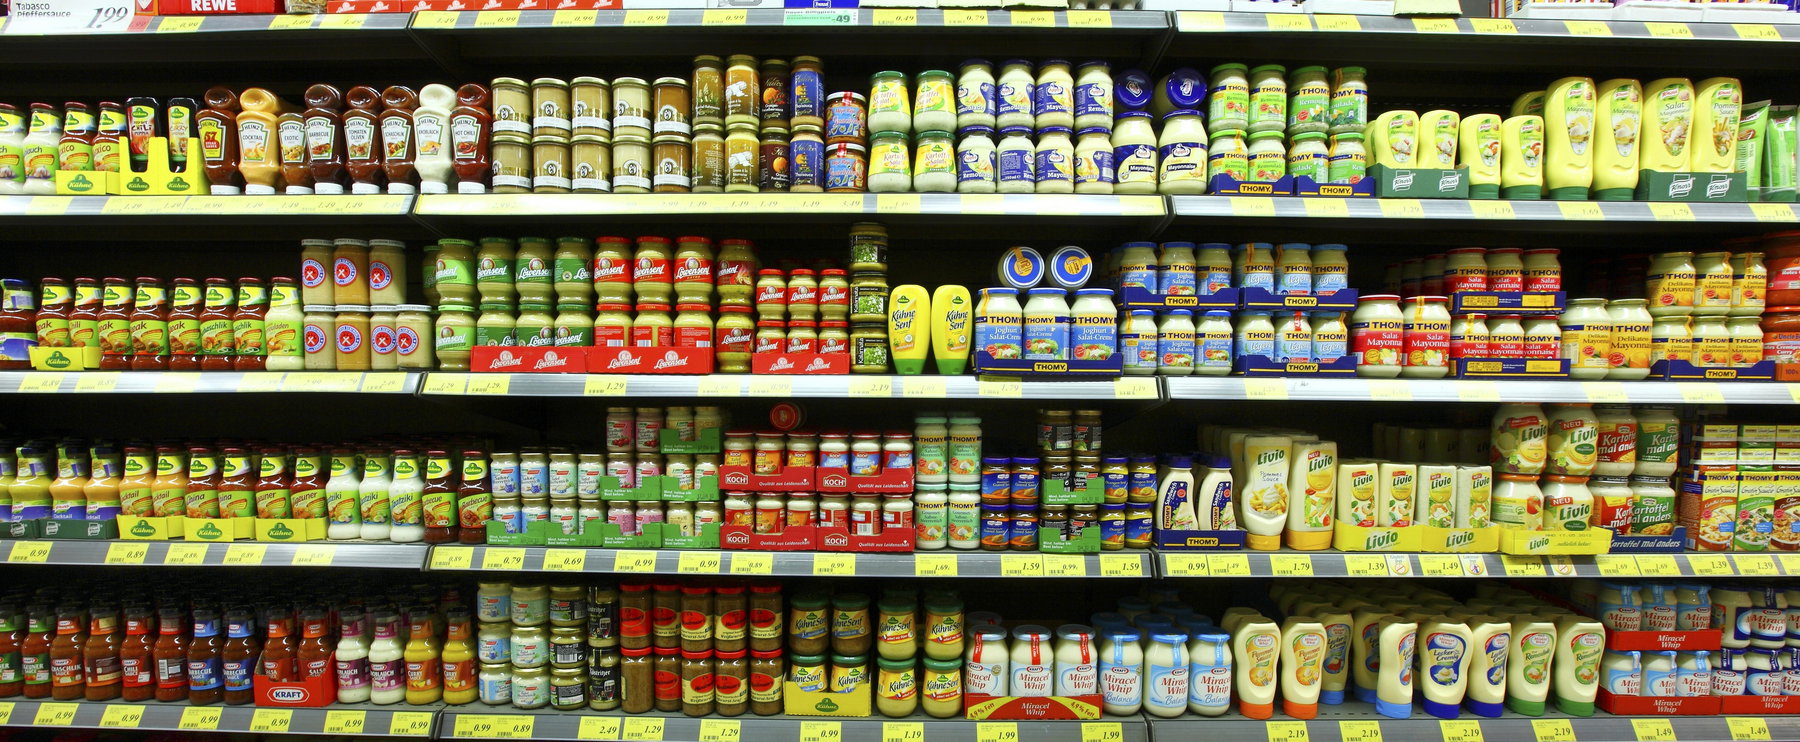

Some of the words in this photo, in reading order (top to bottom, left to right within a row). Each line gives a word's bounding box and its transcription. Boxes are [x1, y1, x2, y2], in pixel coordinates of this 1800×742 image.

[191, 0, 236, 11] REWE
[86, 7, 128, 28] 1.99
[205, 132, 216, 140] 57
[1394, 176, 1413, 185] Knorr
[1441, 176, 1459, 186] Knorr
[1671, 183, 1692, 192] Knorr
[1709, 184, 1729, 192] Knorr
[892, 309, 915, 321] Kühne
[946, 309, 968, 321] Kühne
[895, 320, 913, 331] Senf
[950, 320, 965, 330] Senf
[490, 356, 522, 369] Löwensenf
[534, 356, 567, 370] Löwensenf
[608, 356, 641, 369] Löwensenf
[654, 356, 688, 370] Löwensenf
[1257, 450, 1284, 465] Livio
[1309, 456, 1333, 472] Livio
[1354, 474, 1373, 487] Livio
[1393, 475, 1412, 487] Livio
[1431, 477, 1451, 490] Livio
[1473, 477, 1490, 489] Livio
[1366, 532, 1398, 550] Livio
[1446, 532, 1474, 548] Livio
[1529, 538, 1549, 550] Livio
[1641, 539, 1654, 548] mal
[1655, 539, 1681, 548] anders
[1023, 562, 1040, 570] 1.59
[1442, 562, 1459, 570] 1.49
[1712, 561, 1727, 569] 1.39
[1758, 623, 1783, 632] Whip
[1018, 673, 1049, 683] Miracel
[1024, 681, 1046, 690] Whip
[1073, 681, 1094, 690] Whip
[1712, 684, 1739, 693] Whip
[513, 724, 530, 733] 0.89
[644, 726, 662, 734] 1.29
[1362, 729, 1378, 738] 2.19
[1463, 729, 1480, 737] 2.19
[1656, 728, 1672, 736] 1.49
[904, 730, 921, 739] 1.19
[1288, 730, 1305, 738] 2.19
